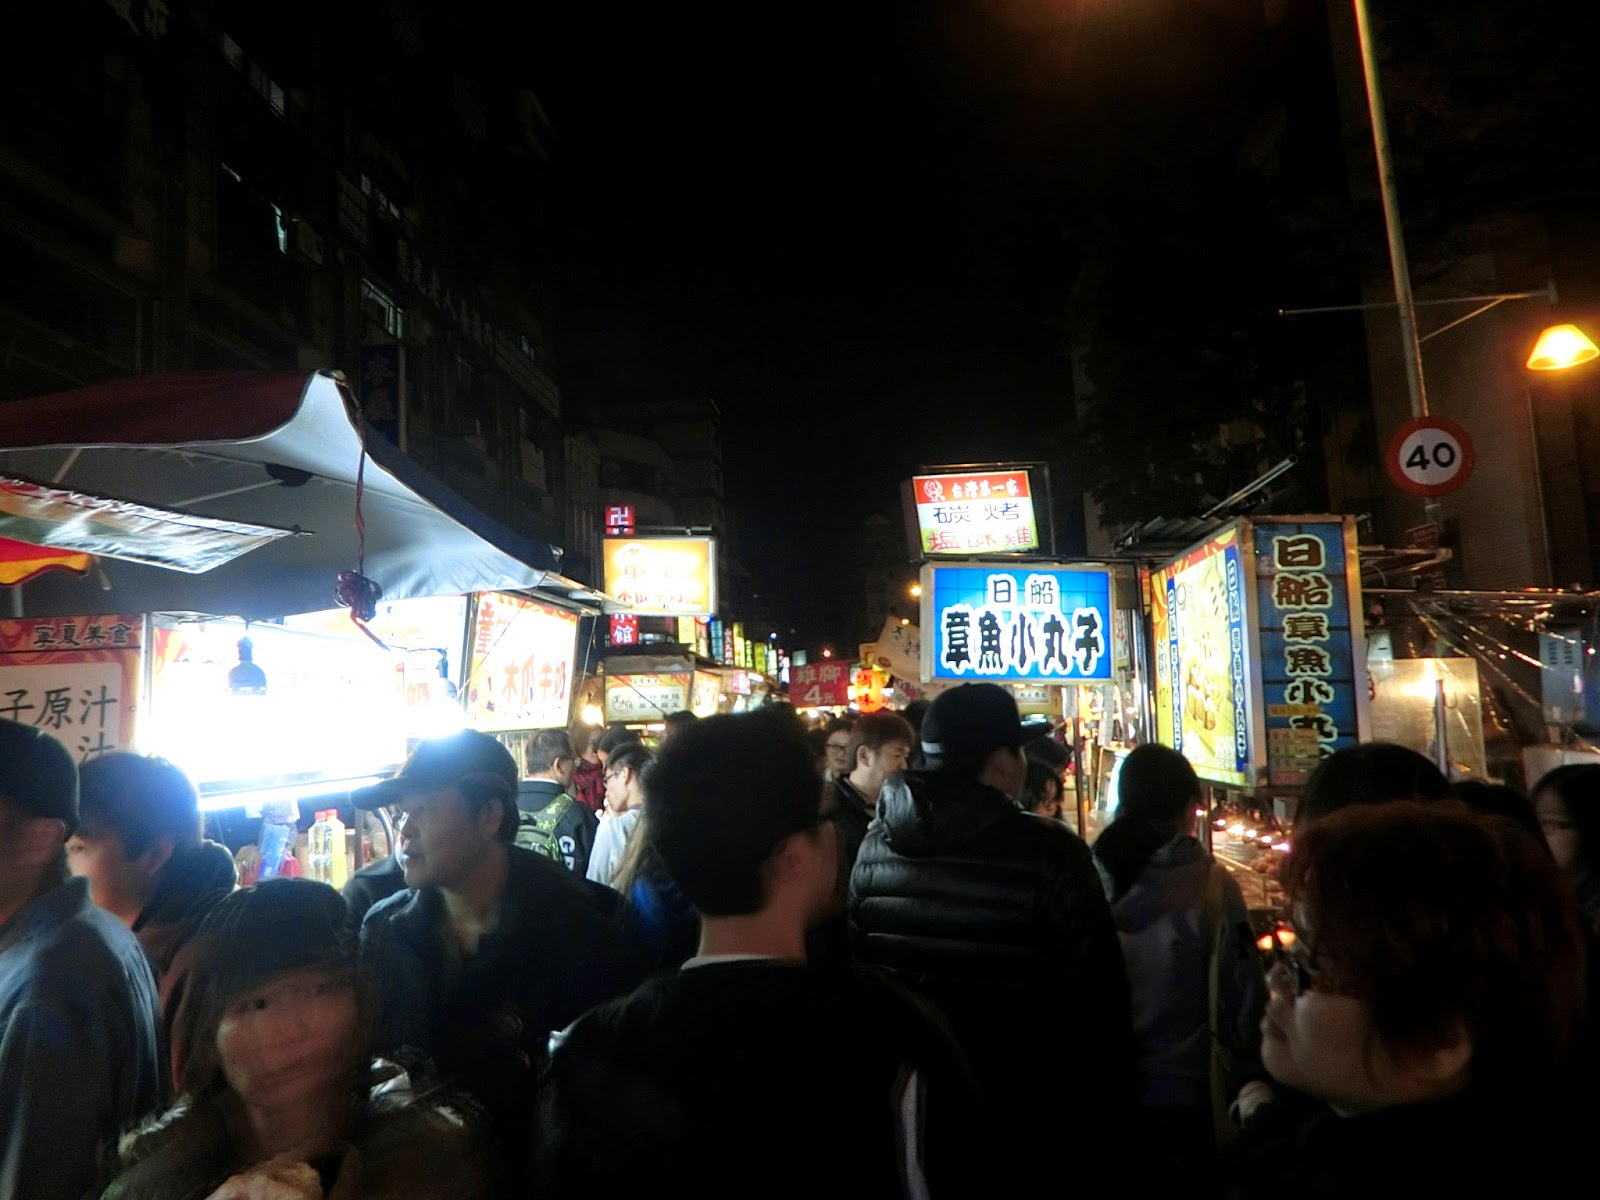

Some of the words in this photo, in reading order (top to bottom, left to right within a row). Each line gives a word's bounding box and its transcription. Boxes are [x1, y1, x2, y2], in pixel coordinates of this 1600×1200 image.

[1406, 442, 1456, 470] 40
[945, 610, 1100, 671] 章魚小丸子
